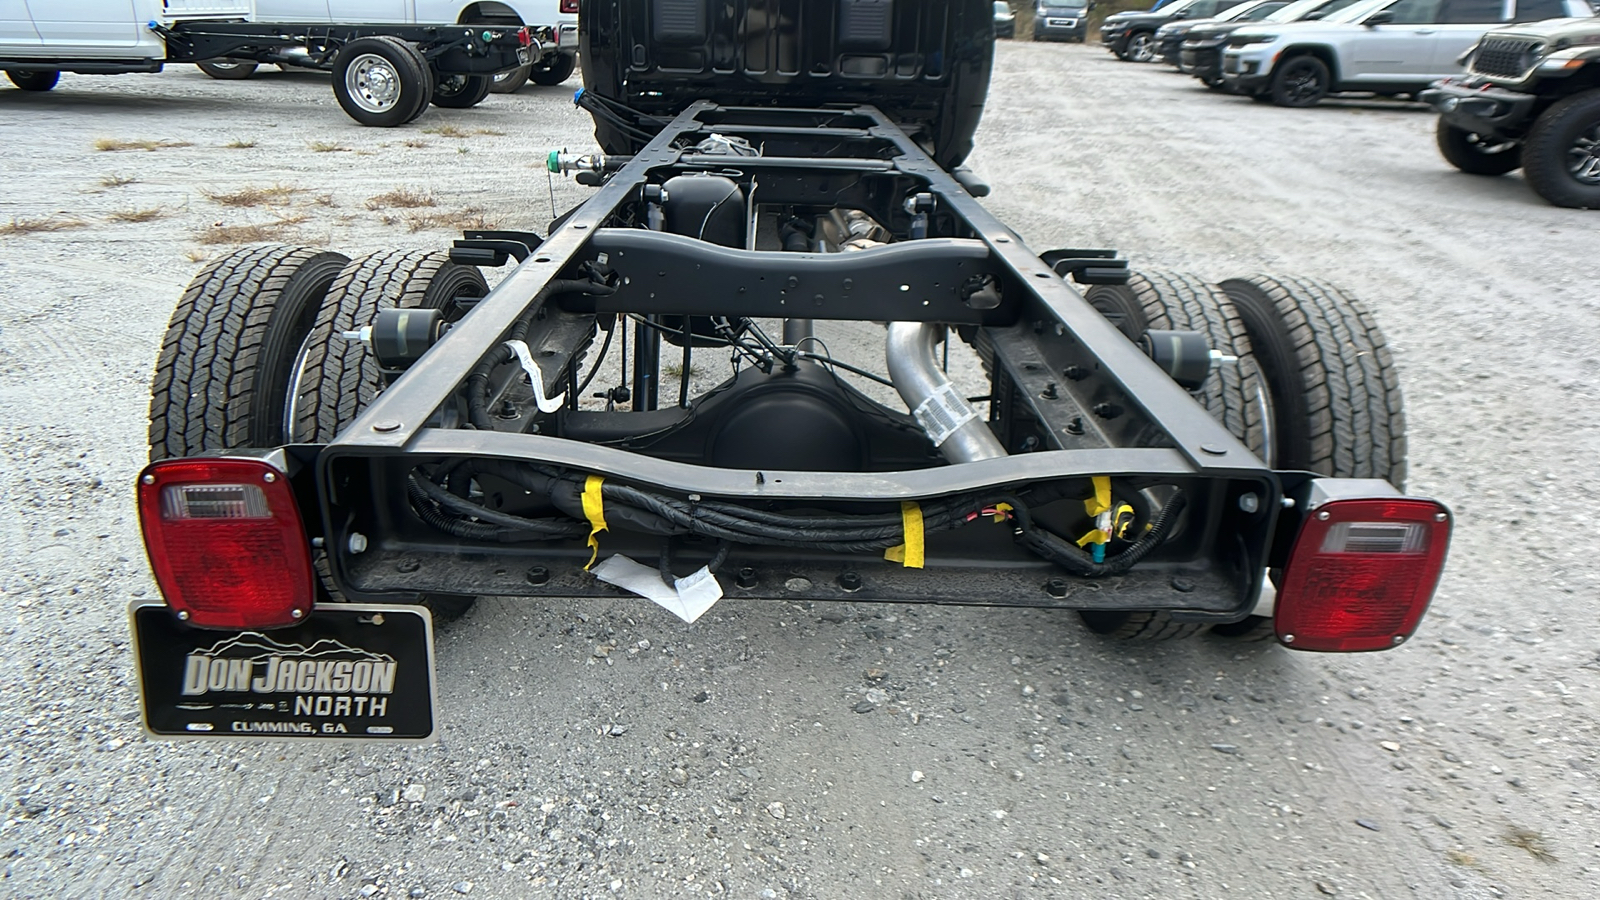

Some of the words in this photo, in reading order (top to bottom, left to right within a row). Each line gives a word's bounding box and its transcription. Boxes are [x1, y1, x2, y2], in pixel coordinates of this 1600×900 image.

[183, 654, 253, 695] DON
[253, 656, 397, 694] JACKSON
[294, 695, 387, 717] NORTH
[232, 721, 317, 735] CUMMING,
[322, 723, 348, 734] GA
